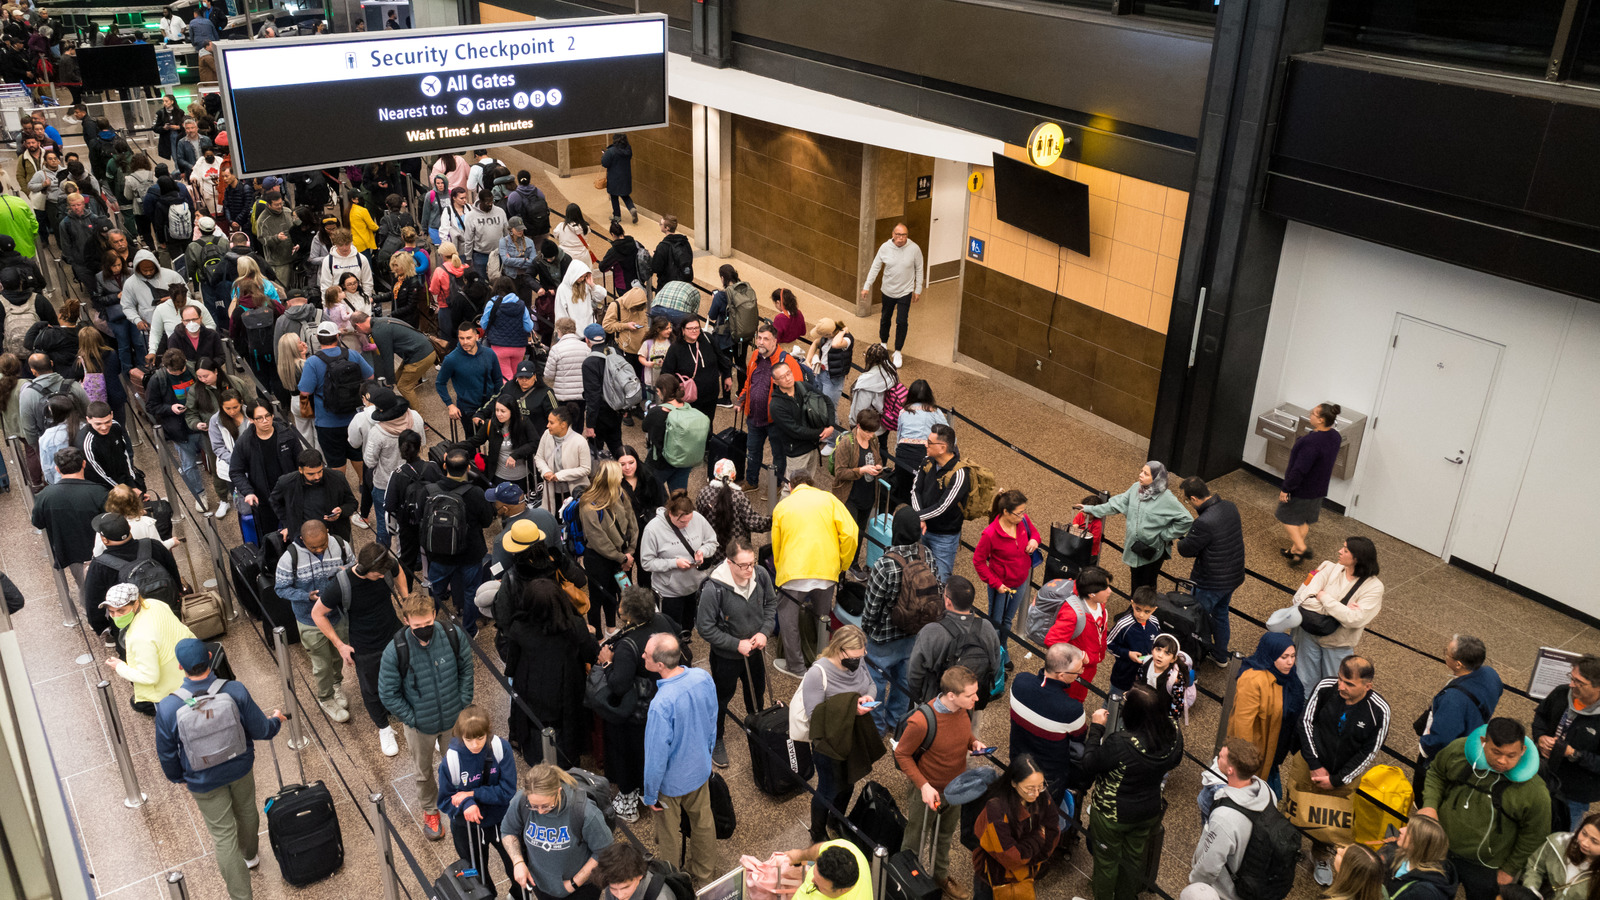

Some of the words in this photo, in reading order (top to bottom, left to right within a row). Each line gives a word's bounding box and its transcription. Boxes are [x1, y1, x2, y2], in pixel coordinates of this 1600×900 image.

[371, 46, 448, 67] Security
[455, 38, 555, 60] Checkpoint
[567, 36, 575, 51] 2
[447, 75, 467, 92] All
[471, 74, 515, 90] Gates
[379, 104, 427, 121] Nearest
[430, 104, 447, 116] to:
[476, 97, 510, 111] Gates
[406, 129, 435, 142] Wait
[437, 127, 470, 138] Time:
[472, 123, 486, 135] 41
[489, 120, 533, 133] minutes
[1308, 805, 1351, 829] NIKE
[526, 821, 570, 844] DECA
